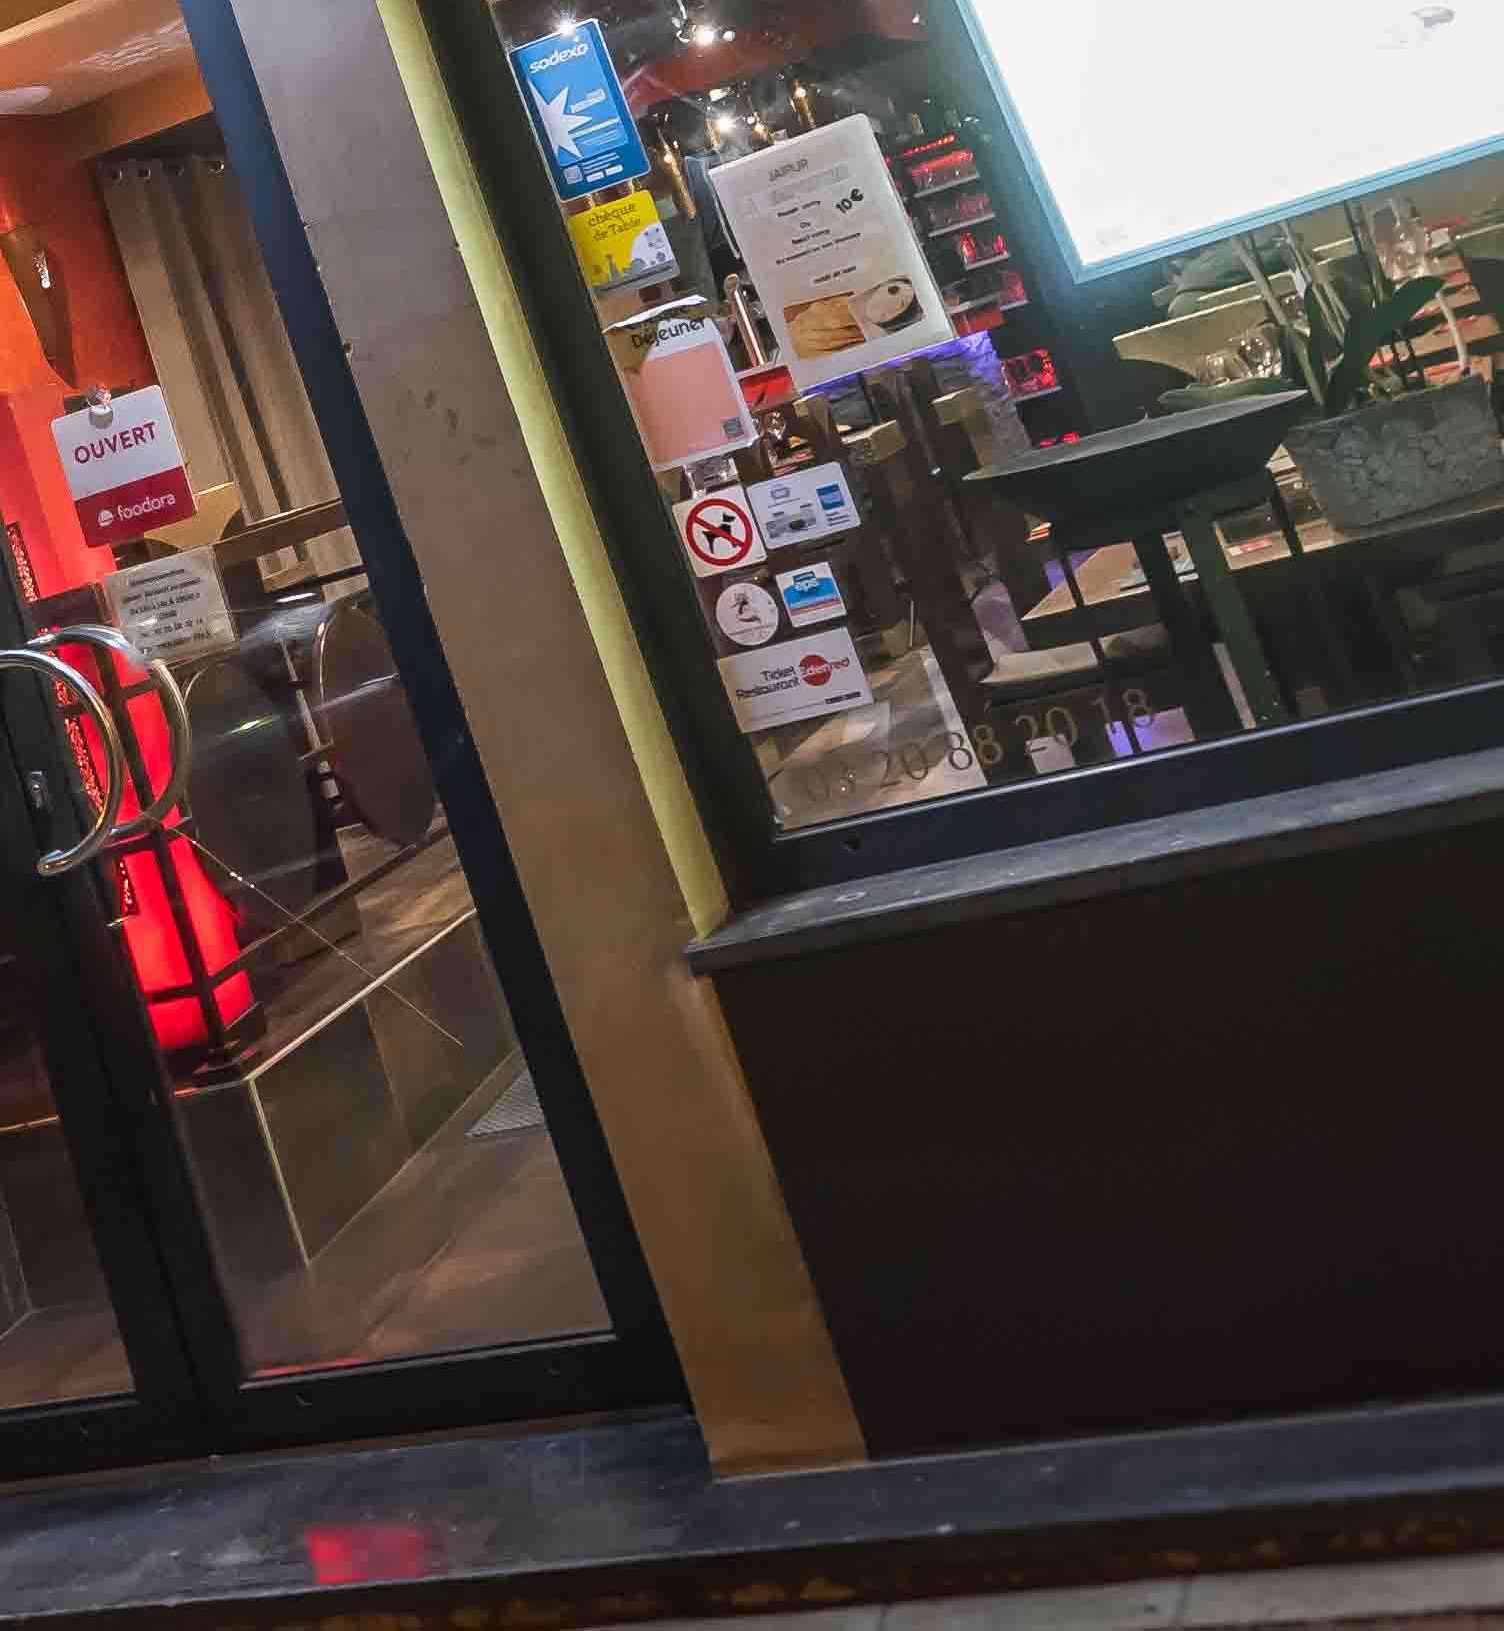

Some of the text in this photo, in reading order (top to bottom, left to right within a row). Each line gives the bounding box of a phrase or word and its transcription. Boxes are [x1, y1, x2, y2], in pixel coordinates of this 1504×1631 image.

[528, 42, 589, 74] sodexo
[73, 421, 158, 465] OUVERT
[116, 491, 177, 521] foodora
[944, 723, 1004, 771] 88
